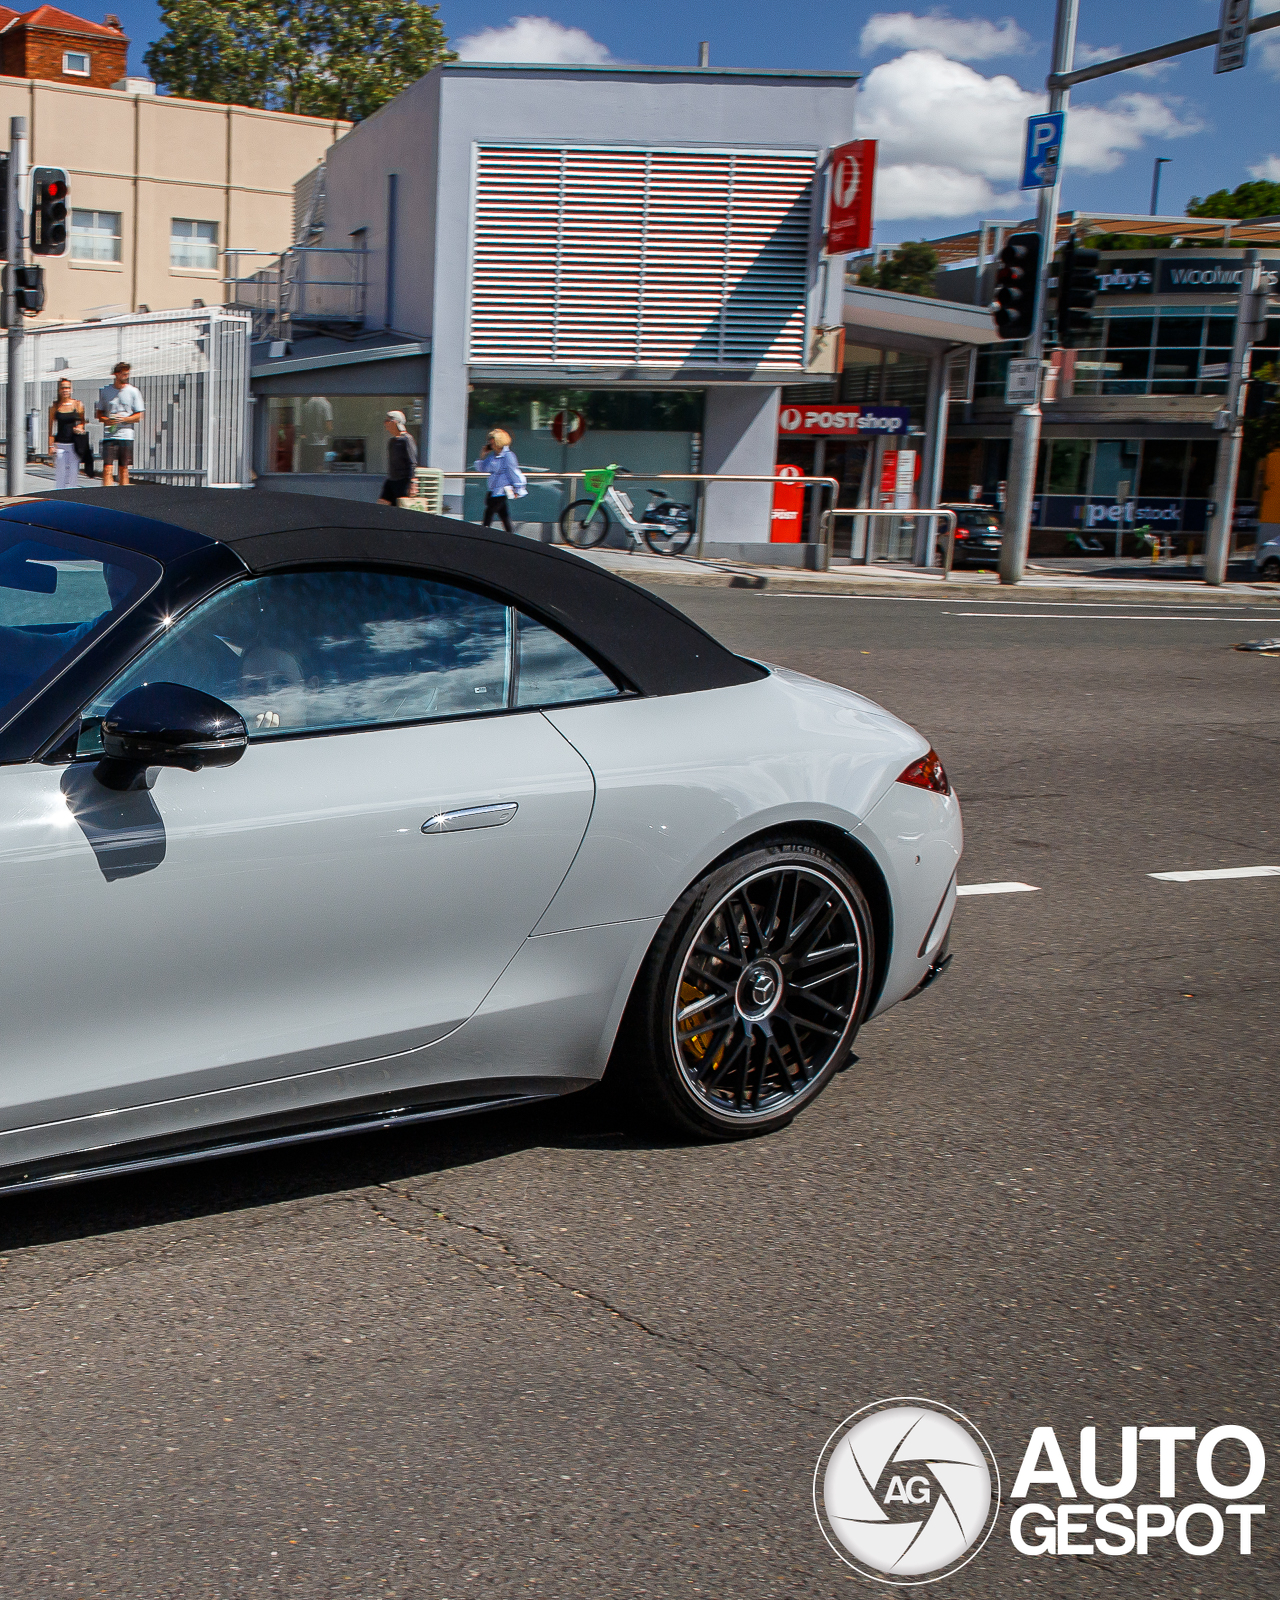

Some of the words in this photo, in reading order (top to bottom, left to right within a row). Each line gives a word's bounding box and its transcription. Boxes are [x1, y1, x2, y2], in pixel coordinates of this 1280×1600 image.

[1031, 123, 1057, 157] P
[1095, 268, 1152, 291] phy's
[1169, 265, 1279, 286] Woolwos
